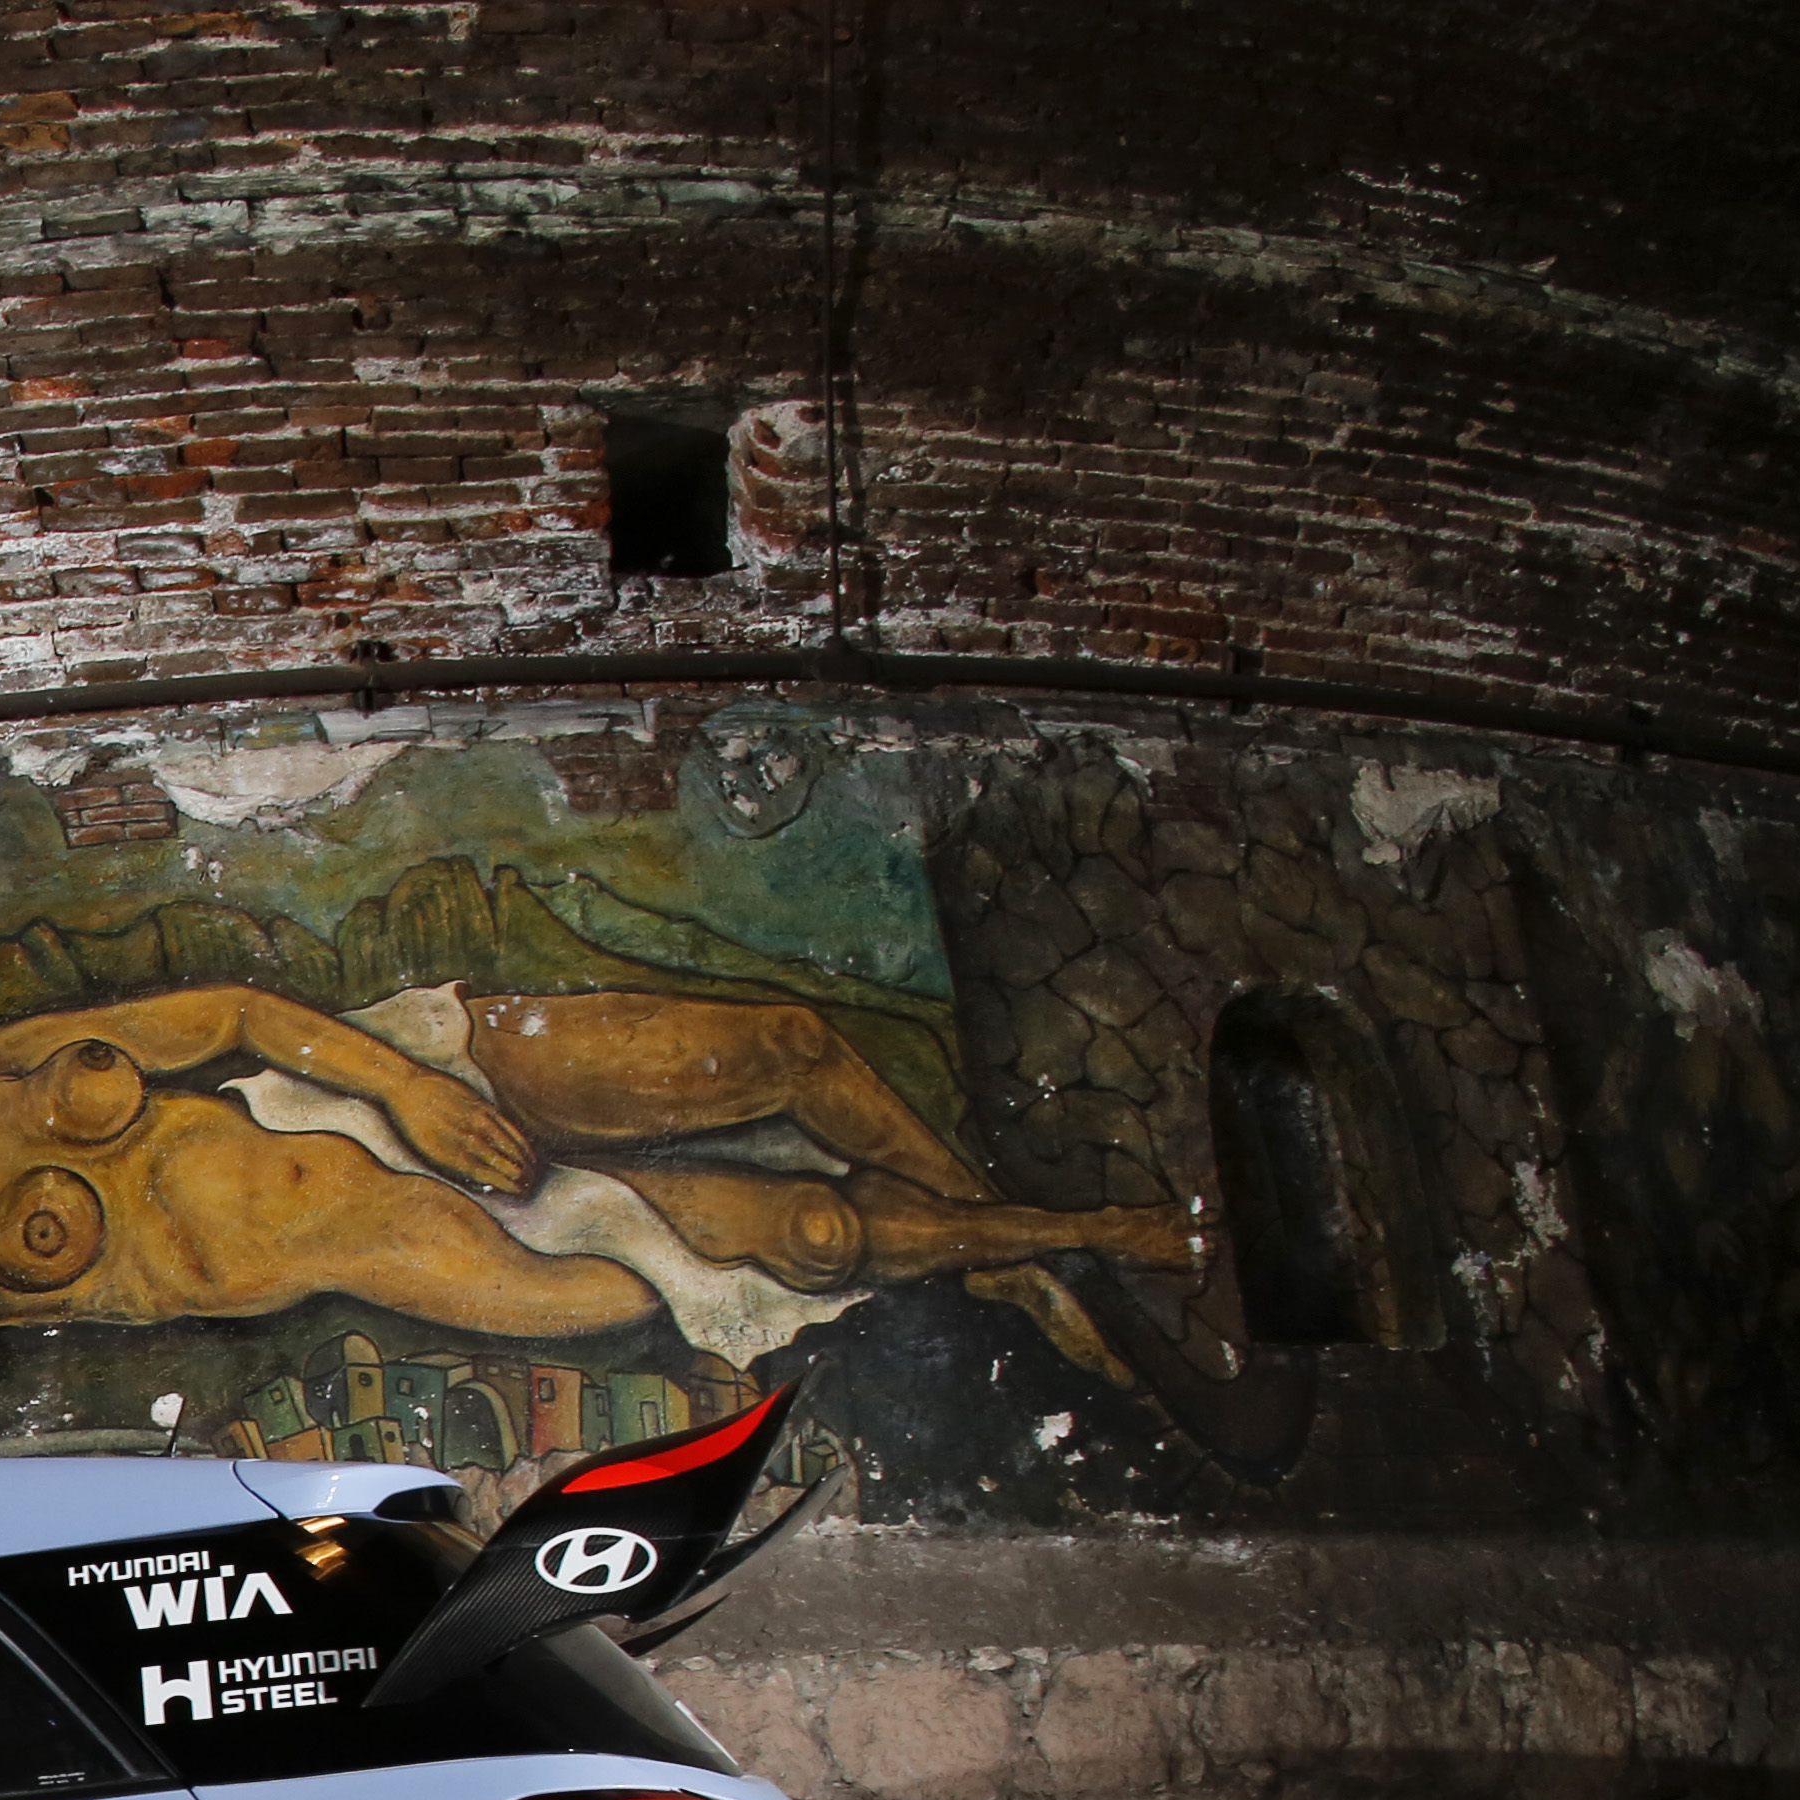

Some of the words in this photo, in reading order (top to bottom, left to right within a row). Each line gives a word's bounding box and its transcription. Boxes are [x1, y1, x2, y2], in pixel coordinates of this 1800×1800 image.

[67, 1550, 211, 1587] HYUNDAI
[218, 1647, 378, 1684] HYUNDAI
[221, 1681, 339, 1715] STEEL
